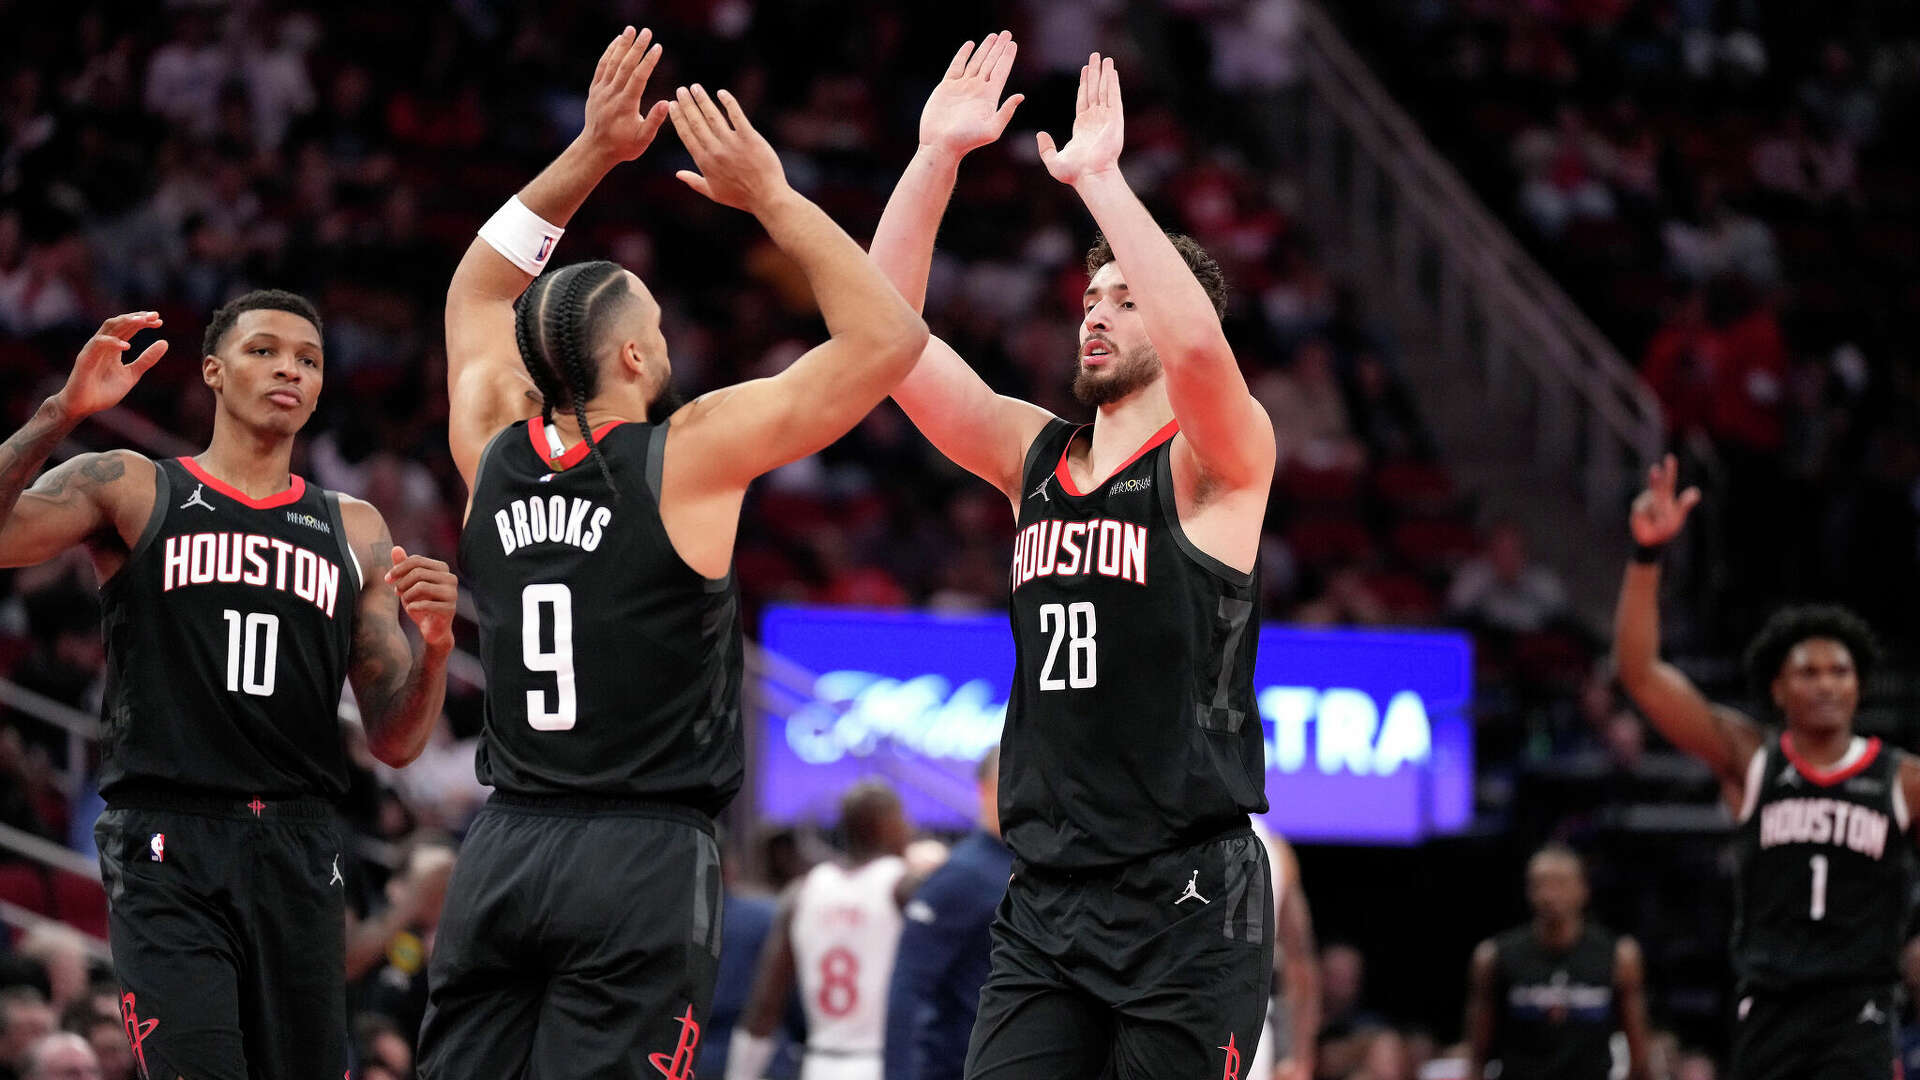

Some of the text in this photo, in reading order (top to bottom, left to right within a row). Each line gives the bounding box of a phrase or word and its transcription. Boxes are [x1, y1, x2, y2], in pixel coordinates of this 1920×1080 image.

[494, 494, 612, 556] BROOKS
[1012, 518, 1148, 594] HOUSTON
[164, 532, 340, 620] HOUSTON
[223, 608, 280, 697] 10
[522, 583, 577, 731] 9
[1039, 601, 1097, 691] 28
[1258, 685, 1432, 777] TRA
[1760, 797, 1889, 861] HOUSTON
[1809, 853, 1829, 921] 1
[818, 944, 860, 1021] 8
